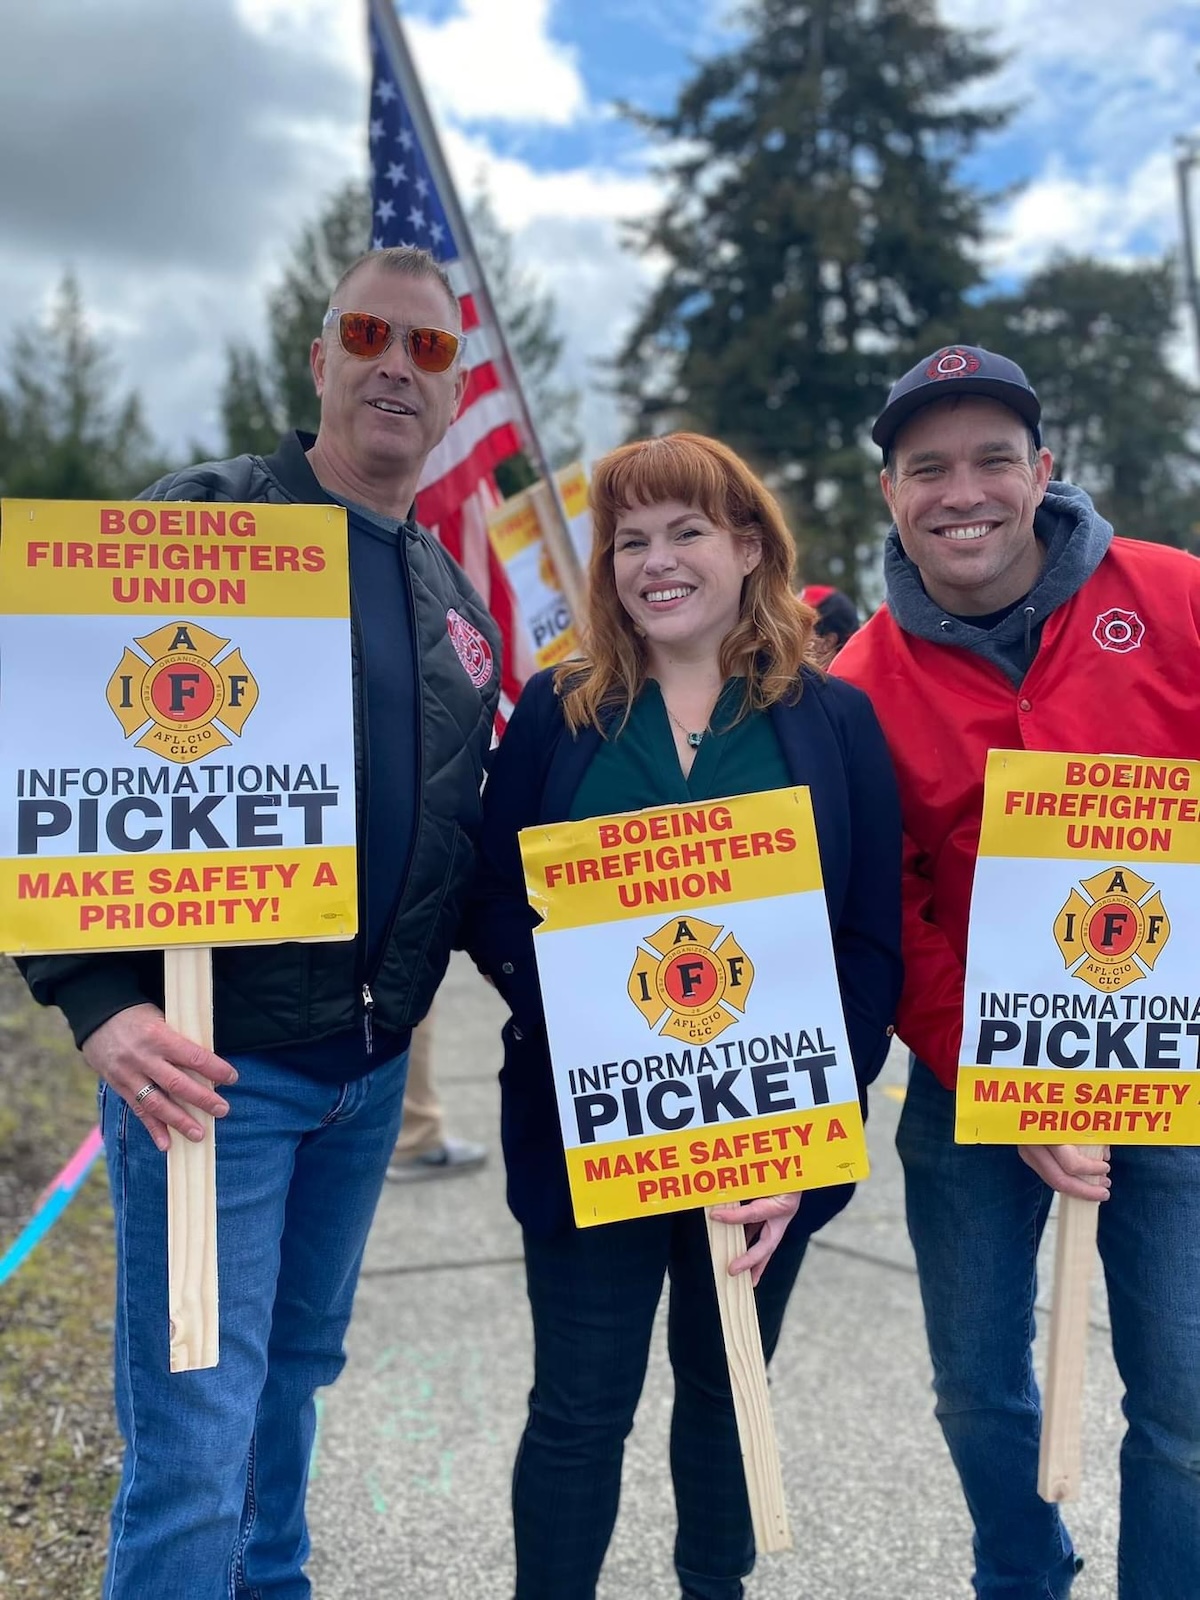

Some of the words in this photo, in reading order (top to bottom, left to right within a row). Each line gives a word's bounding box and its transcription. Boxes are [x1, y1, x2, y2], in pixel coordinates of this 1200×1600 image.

[100, 509, 256, 537] BOEING
[26, 542, 326, 572] FIREFIGHTERS
[112, 577, 246, 604] UNION
[533, 608, 573, 647] PIC
[159, 656, 207, 668] ORGANIZED
[153, 730, 212, 744] AFL-CIO
[170, 746, 198, 754] CLC
[17, 763, 339, 797] INFORMATIONAL
[1065, 762, 1190, 791] BOEING
[1005, 791, 1200, 822] FIREFIGHTE
[17, 792, 338, 855] PICKET
[599, 806, 733, 849] BOEING
[1066, 825, 1172, 851] UNION
[544, 828, 797, 888] FIREFIGHTERS
[18, 870, 135, 899] MAKE
[148, 863, 300, 894] SAFETY
[312, 862, 338, 887] A
[618, 869, 732, 908] UNION
[79, 897, 280, 931] PRIORITY!
[1086, 963, 1131, 976] AFL-CIO
[1098, 977, 1121, 985] CLC
[673, 1011, 721, 1028] AFL-CIO
[689, 1027, 712, 1037] CLC
[568, 1027, 836, 1095] INFORMATIONAL
[573, 1053, 837, 1144] PICKET
[974, 1080, 1064, 1104] MAKE
[1074, 1083, 1190, 1105] SAFETY
[1019, 1111, 1172, 1132] PRIORITY!
[584, 1146, 679, 1182] MAKE
[690, 1123, 813, 1164] SAFETY
[826, 1118, 848, 1142] A
[637, 1155, 803, 1203] PRIORITY!
